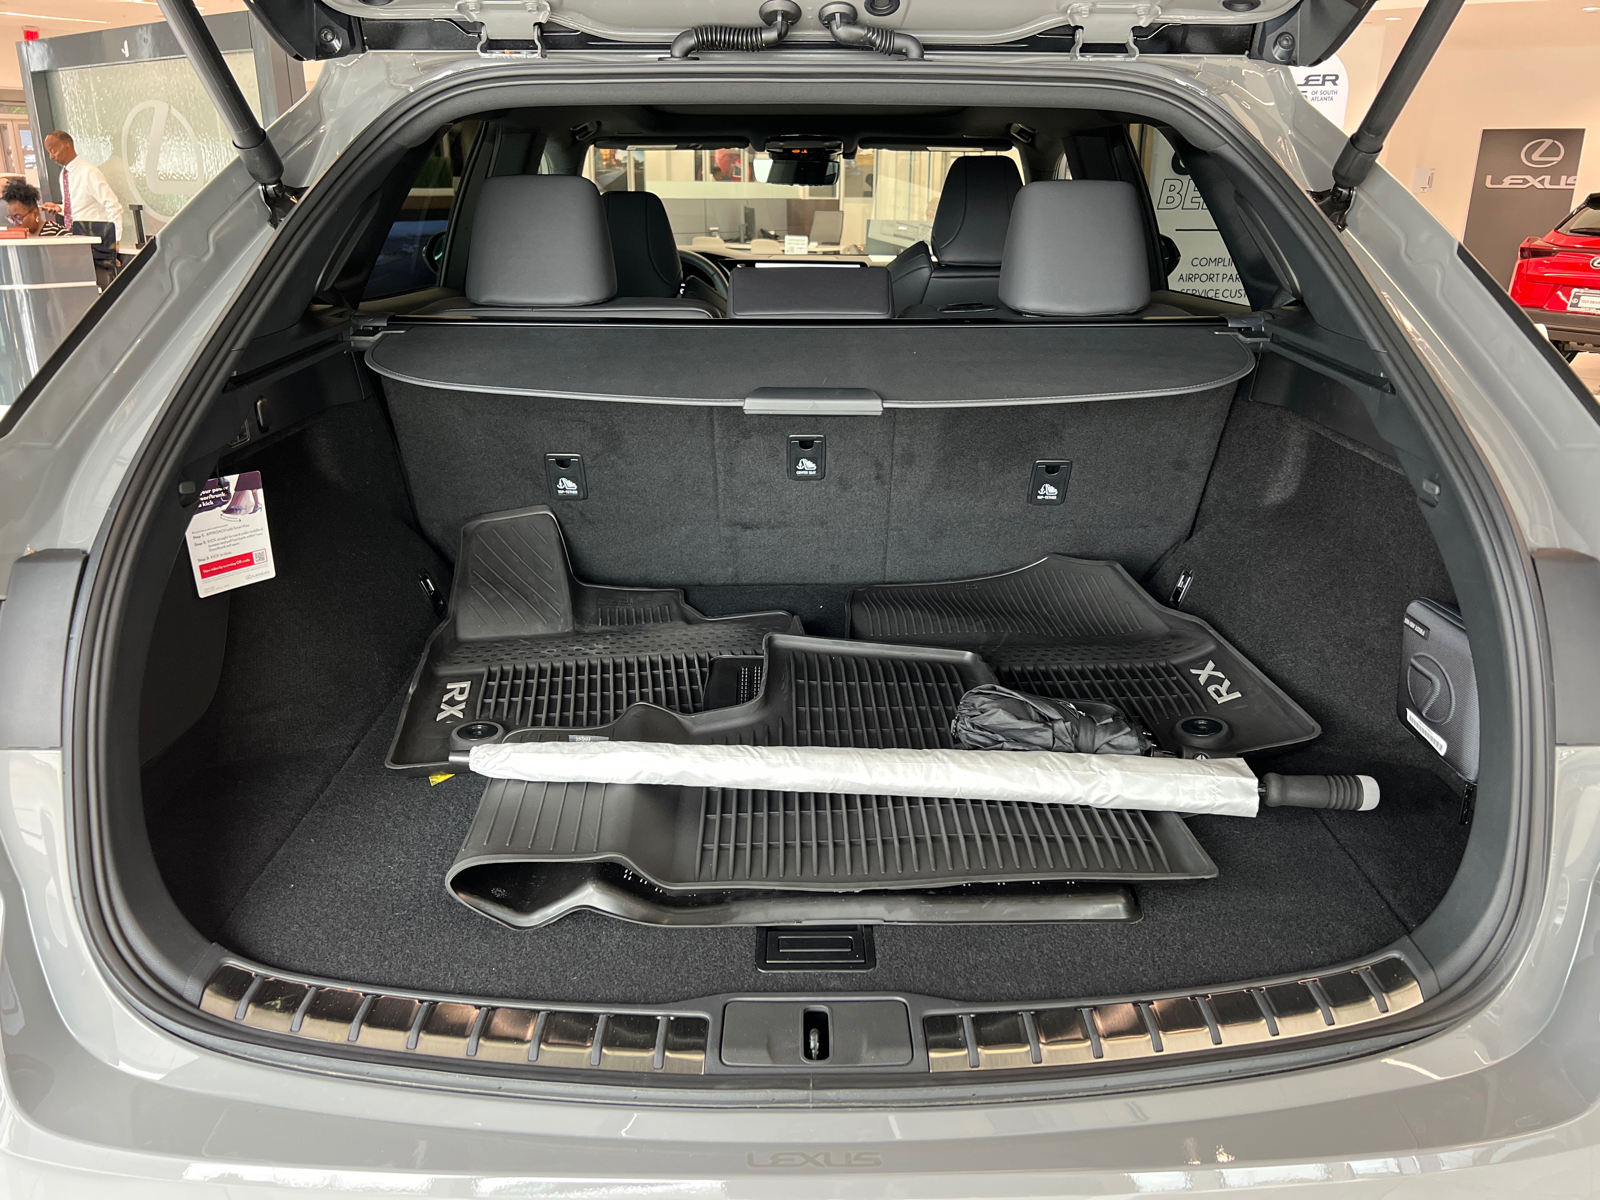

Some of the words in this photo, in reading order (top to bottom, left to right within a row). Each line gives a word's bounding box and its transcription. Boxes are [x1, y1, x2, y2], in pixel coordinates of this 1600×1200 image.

[1157, 178, 1208, 210] BE
[1178, 272, 1220, 282] AIRPORT
[1190, 660, 1242, 704] RX
[436, 681, 471, 721] RX
[747, 1151, 882, 1168] LEXUS
